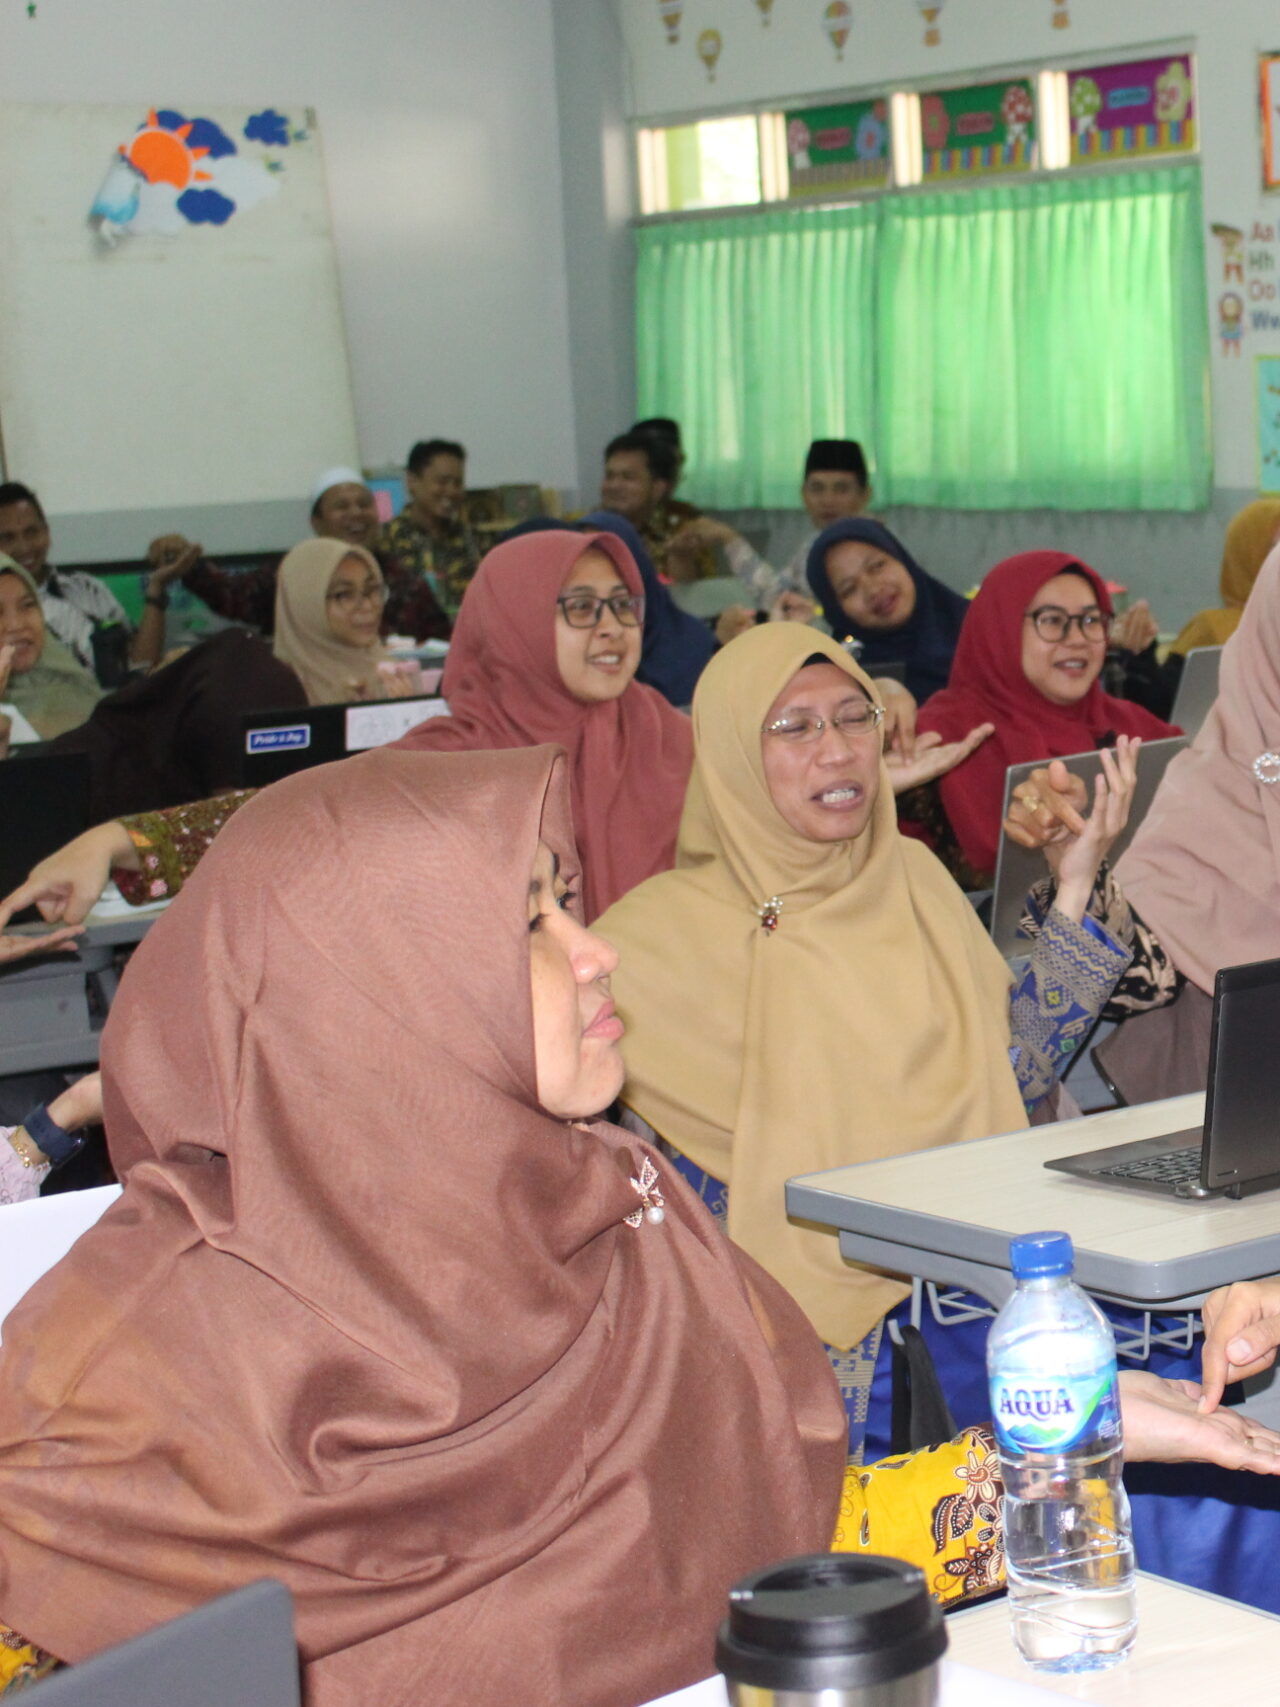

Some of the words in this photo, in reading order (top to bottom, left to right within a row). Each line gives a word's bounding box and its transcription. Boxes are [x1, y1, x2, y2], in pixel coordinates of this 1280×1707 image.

[1252, 221, 1274, 242] Aa
[1249, 279, 1275, 302] Oo
[1000, 1387, 1075, 1422] AQUA
